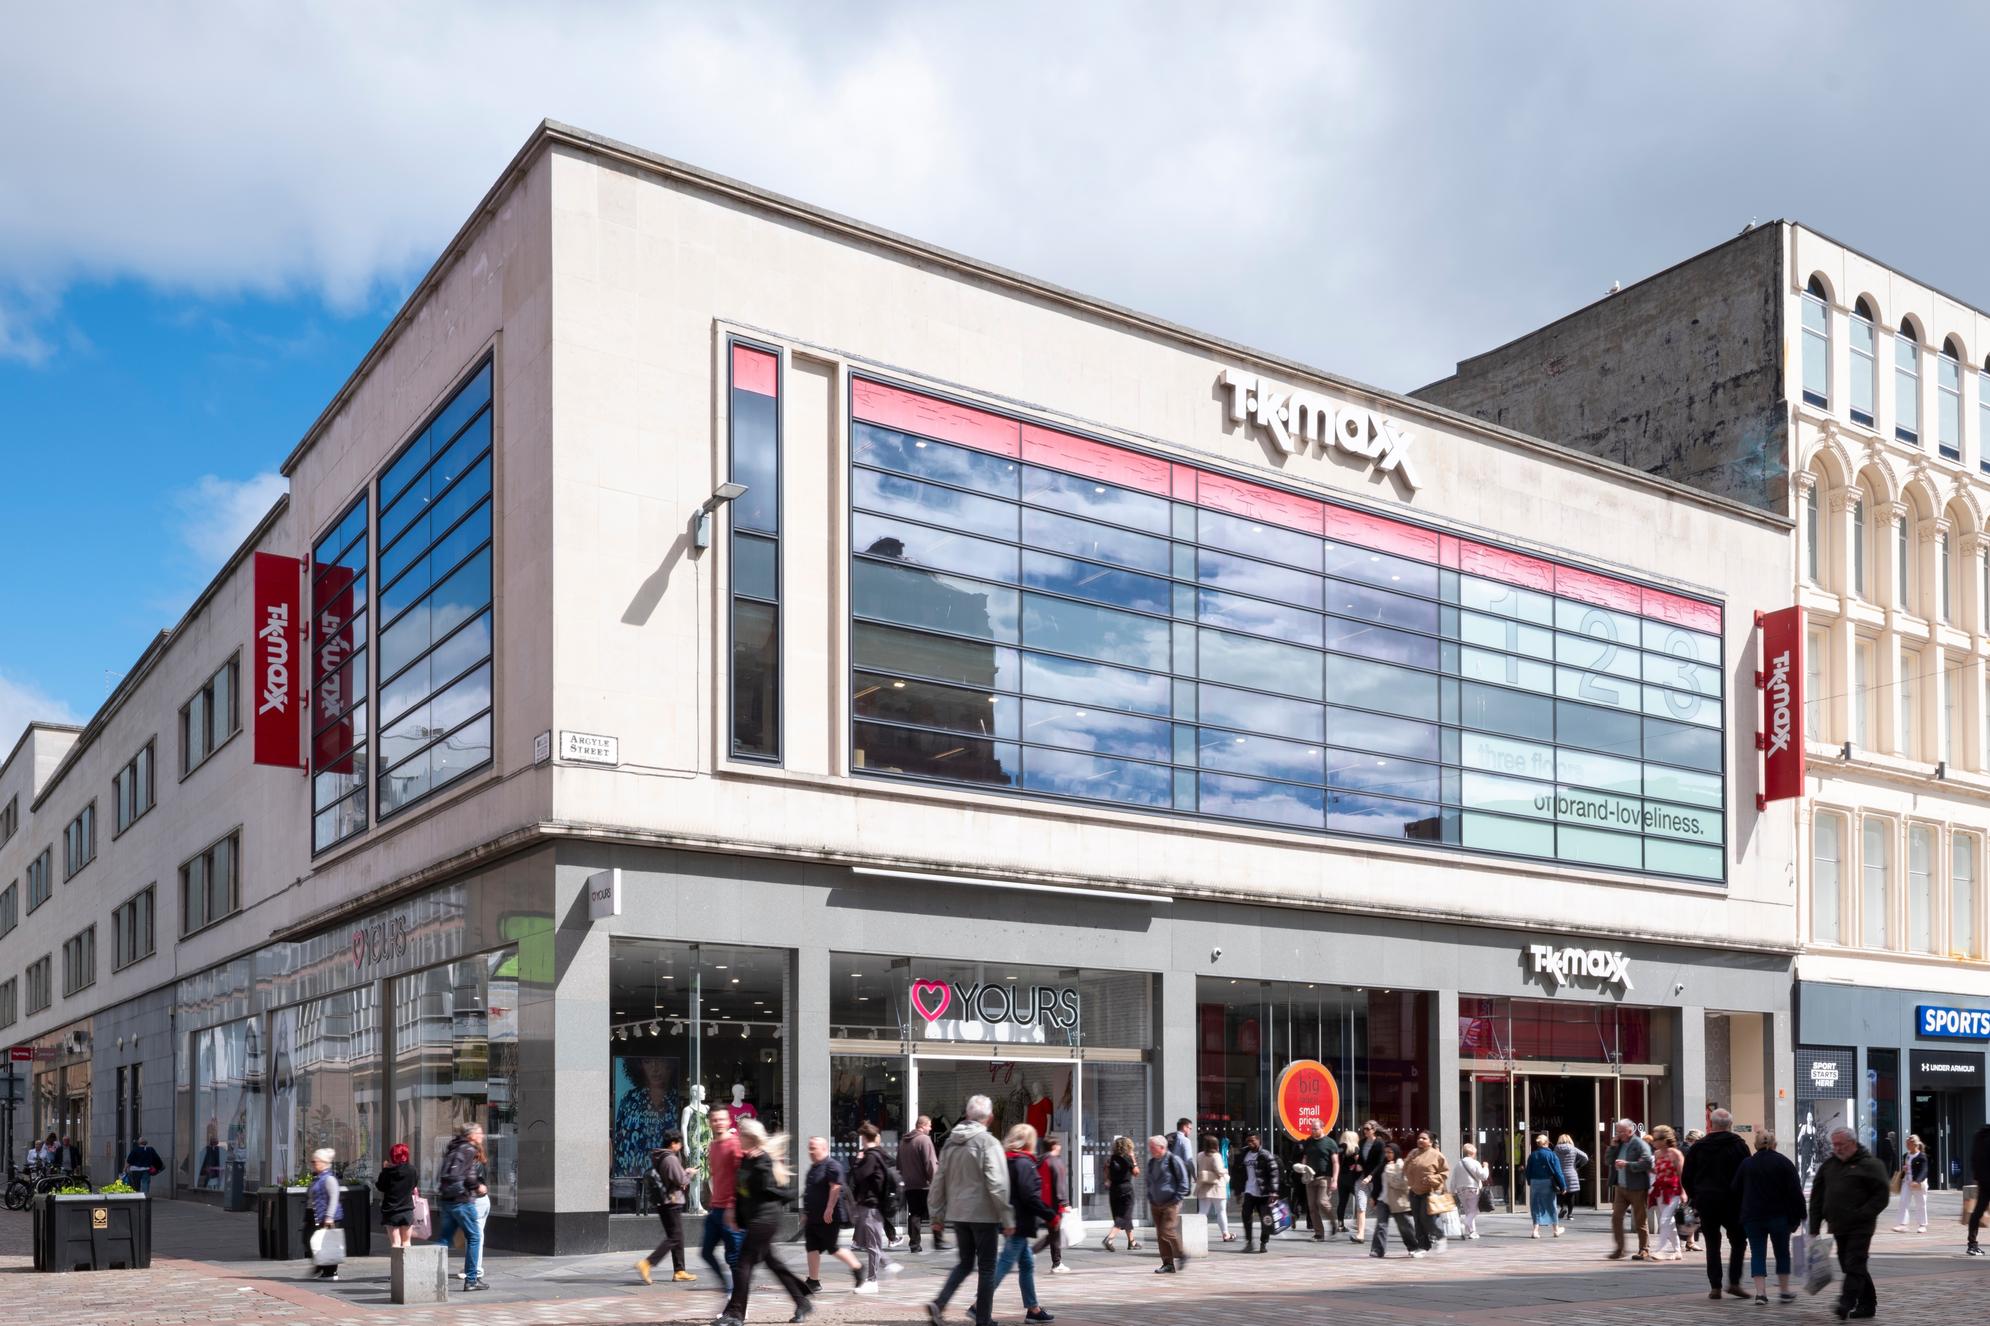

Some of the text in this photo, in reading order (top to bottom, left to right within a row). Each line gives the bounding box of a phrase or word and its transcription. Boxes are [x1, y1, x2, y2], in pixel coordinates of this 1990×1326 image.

[570, 744, 610, 757] STREET
[1478, 743, 1526, 771] three
[953, 981, 1079, 1029] YOURS
[1924, 1008, 1990, 1035] SPORTS
[1812, 1061, 1837, 1070] SPORT
[1930, 1064, 1975, 1073] UNDER ARMOUR
[1812, 1070, 1838, 1078] STARTS
[1299, 1070, 1320, 1095] big
[1815, 1079, 1835, 1087] HERE
[1299, 1105, 1320, 1116] small
[1298, 1115, 1320, 1128] pric
